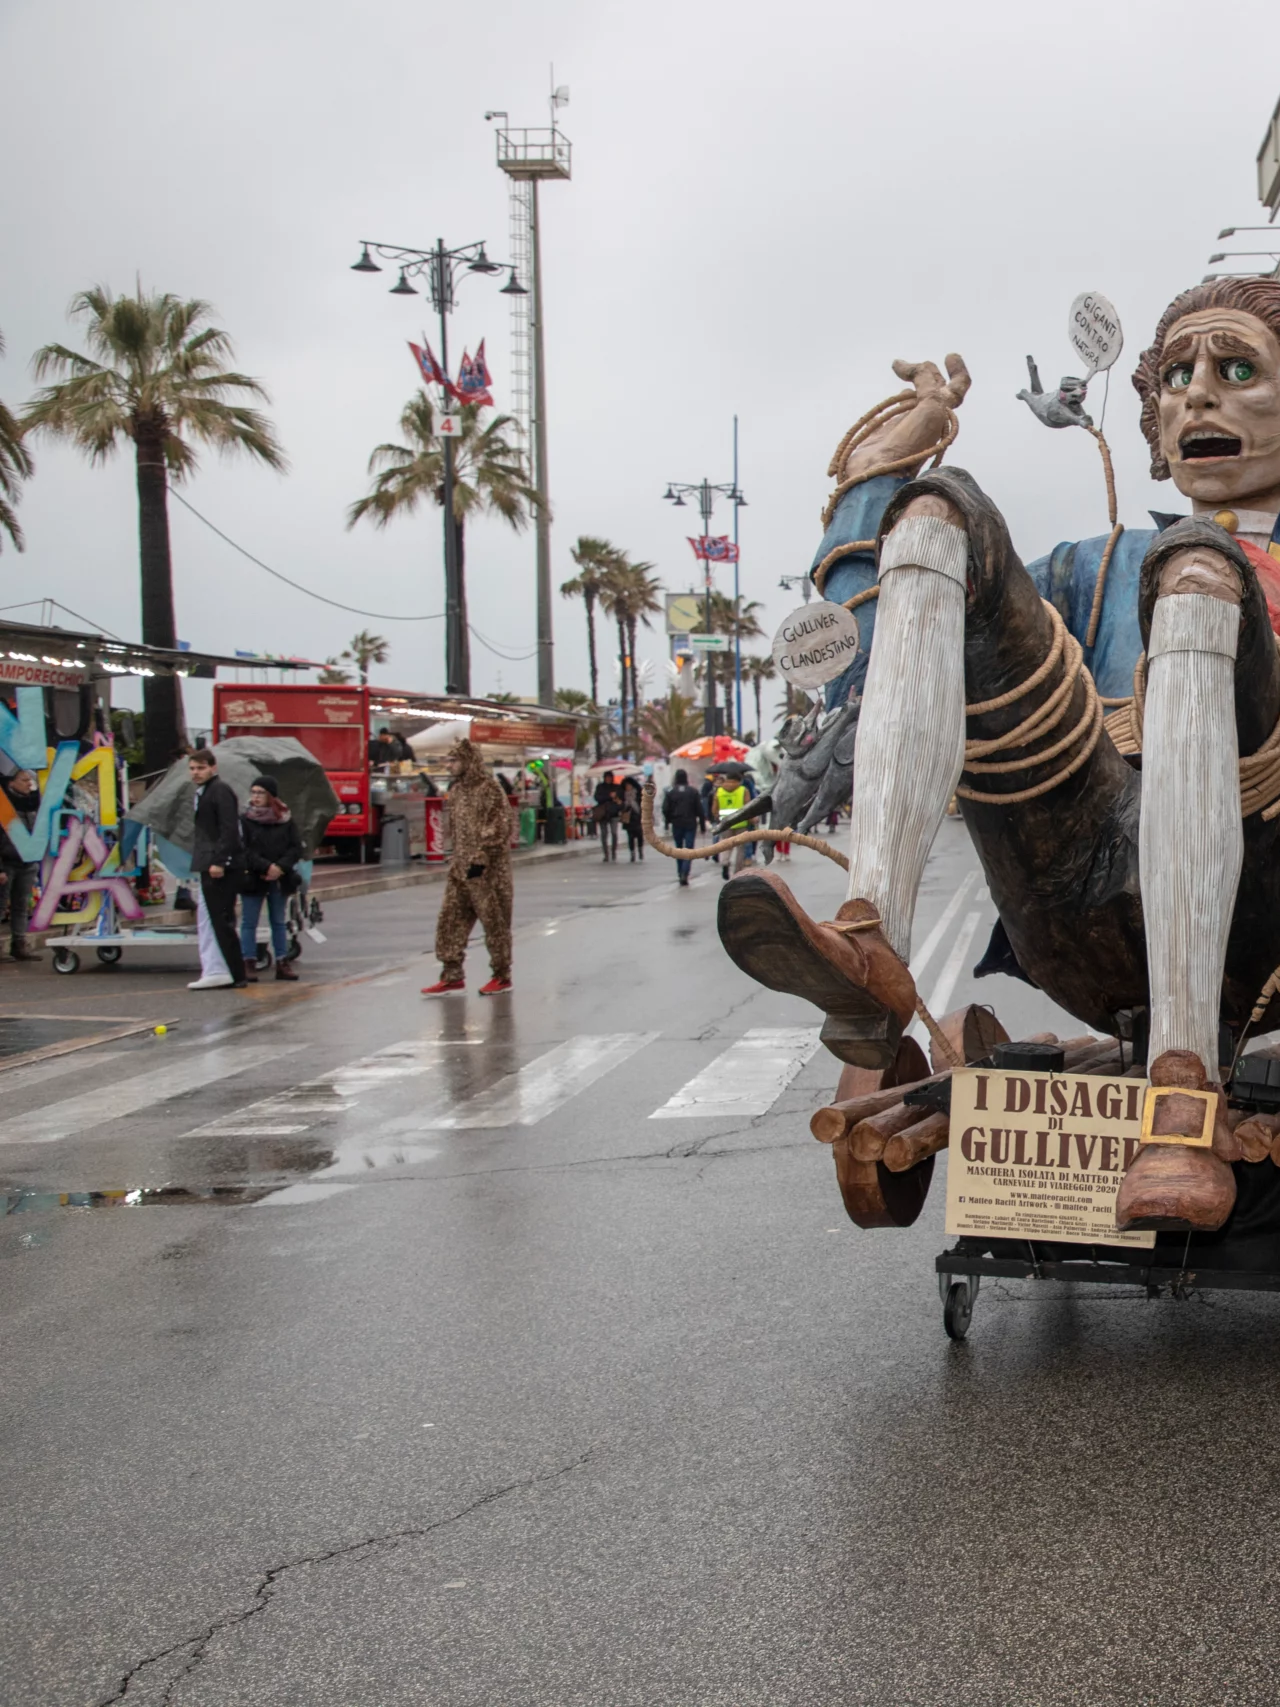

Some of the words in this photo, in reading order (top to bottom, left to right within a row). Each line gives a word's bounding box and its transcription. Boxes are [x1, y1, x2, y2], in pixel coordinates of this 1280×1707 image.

[1083, 296, 1117, 338] GIGANTI
[1074, 311, 1109, 353] CONTRO
[1072, 334, 1101, 368] NATURA
[440, 418, 454, 433] 4
[782, 613, 839, 643] GULLIVER
[780, 635, 856, 670] CLANDESTINO
[974, 1075, 990, 1111] I
[1004, 1077, 1141, 1120] DISAGI
[1048, 1117, 1063, 1130] DI
[967, 1166, 1015, 1178] MASCHERA
[1019, 1169, 1055, 1180] ISOLATA
[1059, 1172, 1069, 1181] DI
[1073, 1173, 1109, 1184] MATTEO
[993, 1178, 1035, 1188] CARNEVALE
[1038, 1181, 1047, 1189] DI
[1050, 1182, 1093, 1192] VIAREGGIO
[1096, 1185, 1116, 1193] 2020
[969, 1197, 993, 1205] Matteo
[1019, 1200, 1047, 1208] Artwork
[1011, 1192, 1093, 1204] www.matteoraciti.com
